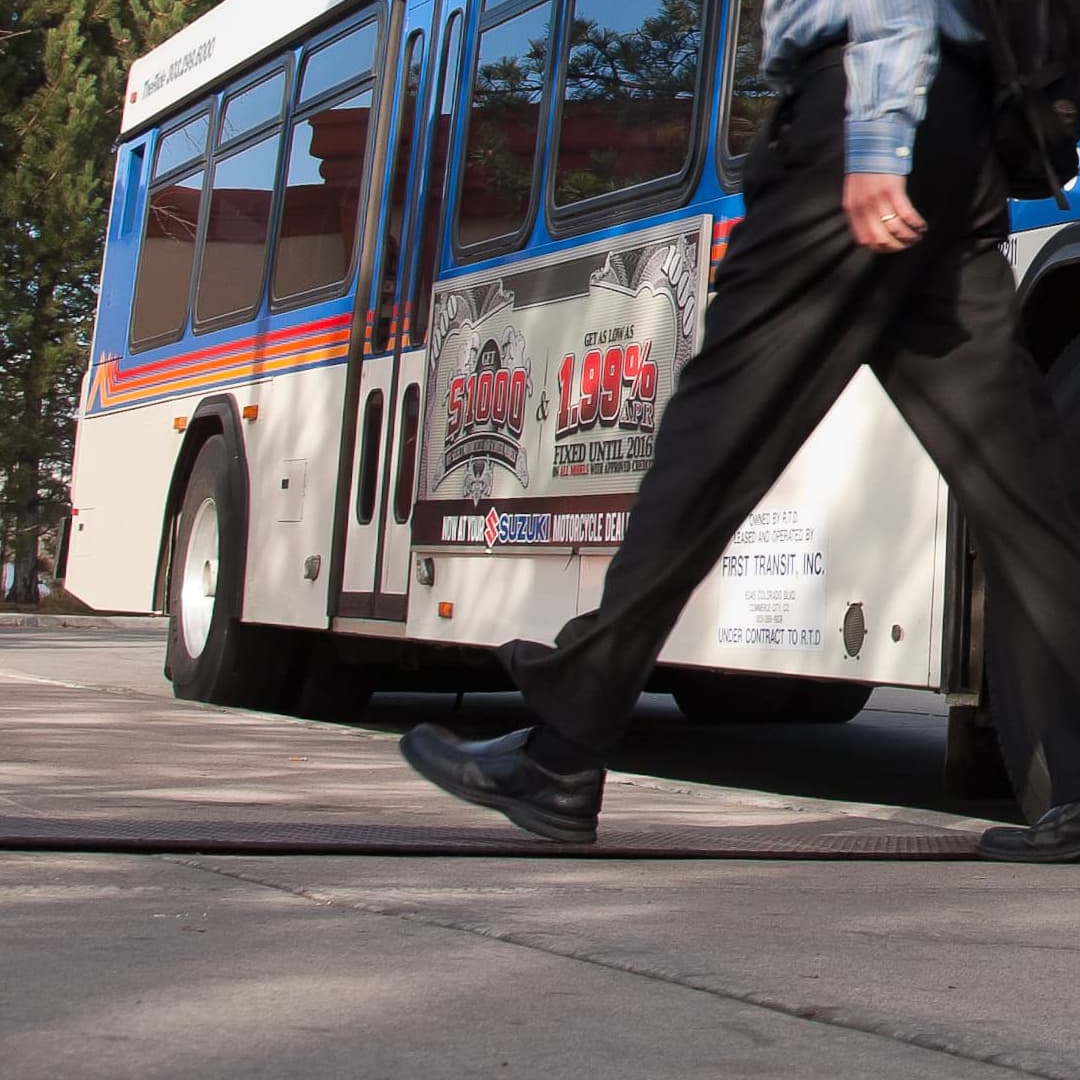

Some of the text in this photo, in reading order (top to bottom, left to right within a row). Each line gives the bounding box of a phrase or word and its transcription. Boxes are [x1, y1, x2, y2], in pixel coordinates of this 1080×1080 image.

[584, 331, 598, 347] GET
[597, 329, 607, 344] AS
[624, 324, 634, 340] AS
[555, 338, 658, 439] 1.99%
[619, 400, 654, 431] APR
[553, 435, 654, 465] FIXED UNTIL 2016
[457, 515, 467, 542] AT
[466, 515, 485, 542] YOUR
[498, 513, 551, 544] SUZUKI
[552, 513, 604, 542] MOTORCYCLE
[722, 555, 750, 576] FIRST
[803, 552, 825, 575] INC.
[718, 628, 743, 643] UNDER
[745, 627, 785, 645] CONTRACT
[787, 629, 798, 645] TO
